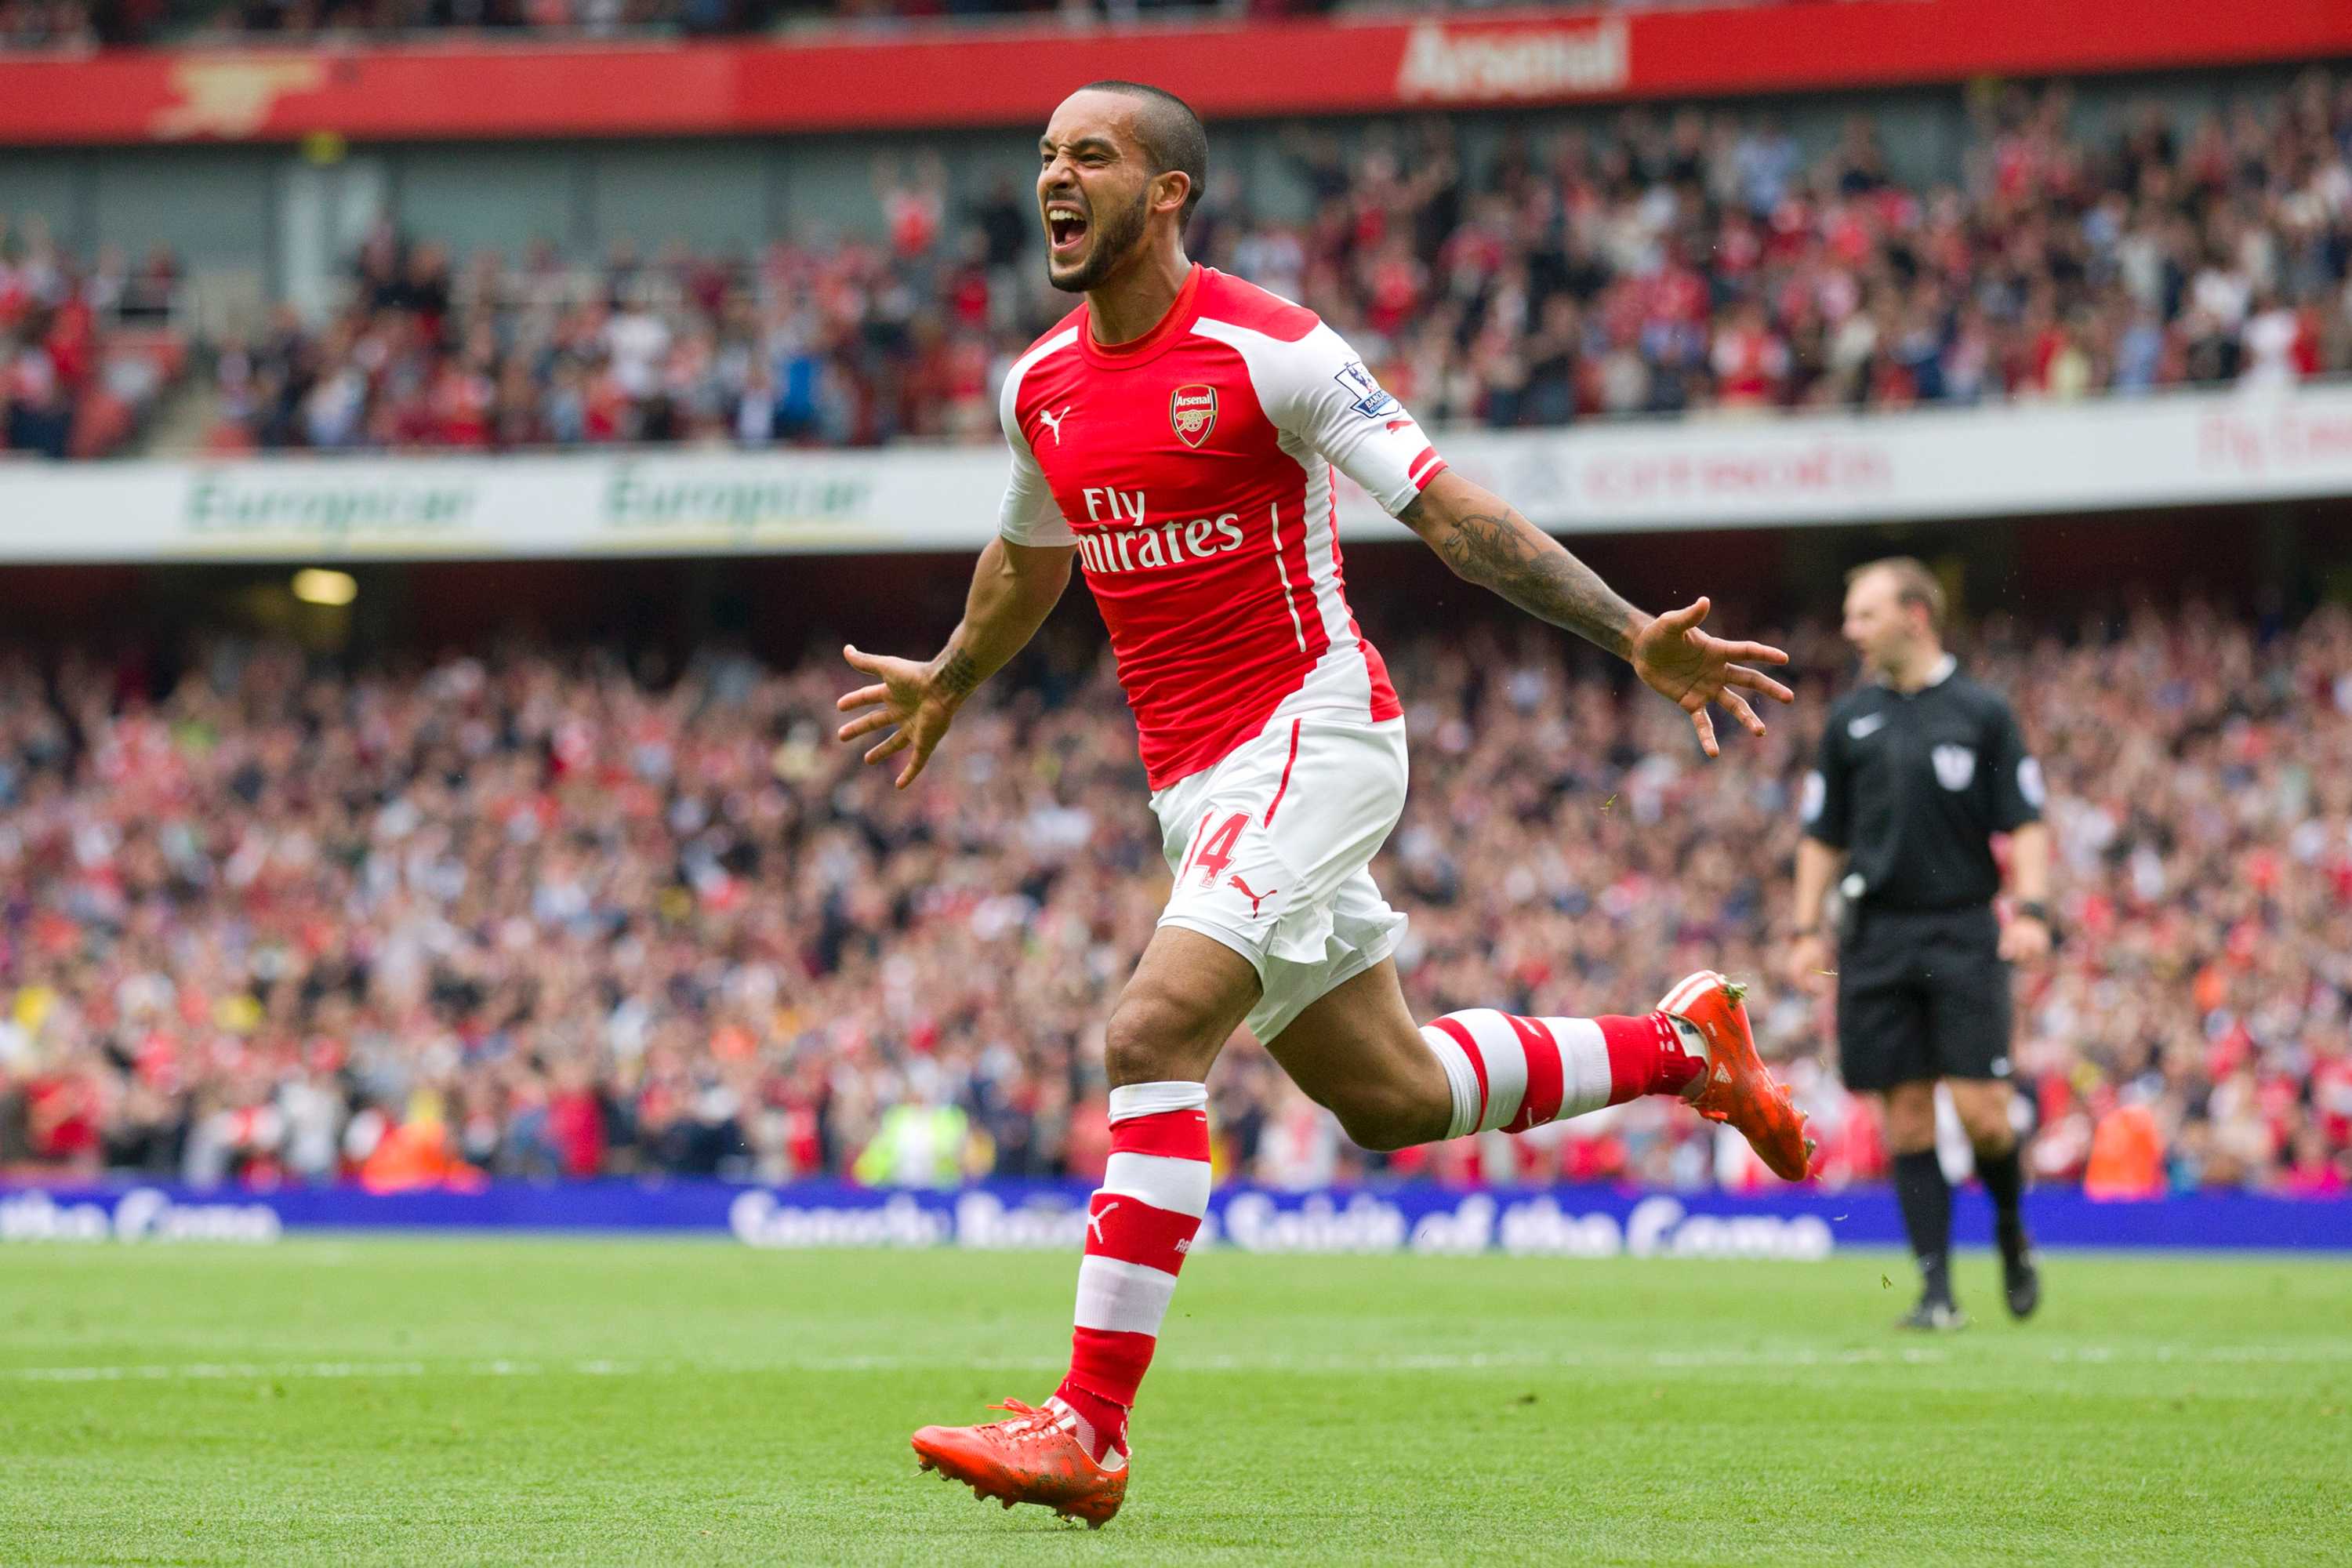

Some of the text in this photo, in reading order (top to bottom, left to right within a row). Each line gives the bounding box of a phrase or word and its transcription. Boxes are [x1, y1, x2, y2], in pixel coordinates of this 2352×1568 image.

[1399, 19, 1628, 97] Arsenal
[1176, 394, 1210, 406] Arsenal
[1083, 486, 1145, 526] Fly
[1078, 513, 1243, 573] mirates
[1176, 807, 1253, 888] 14
